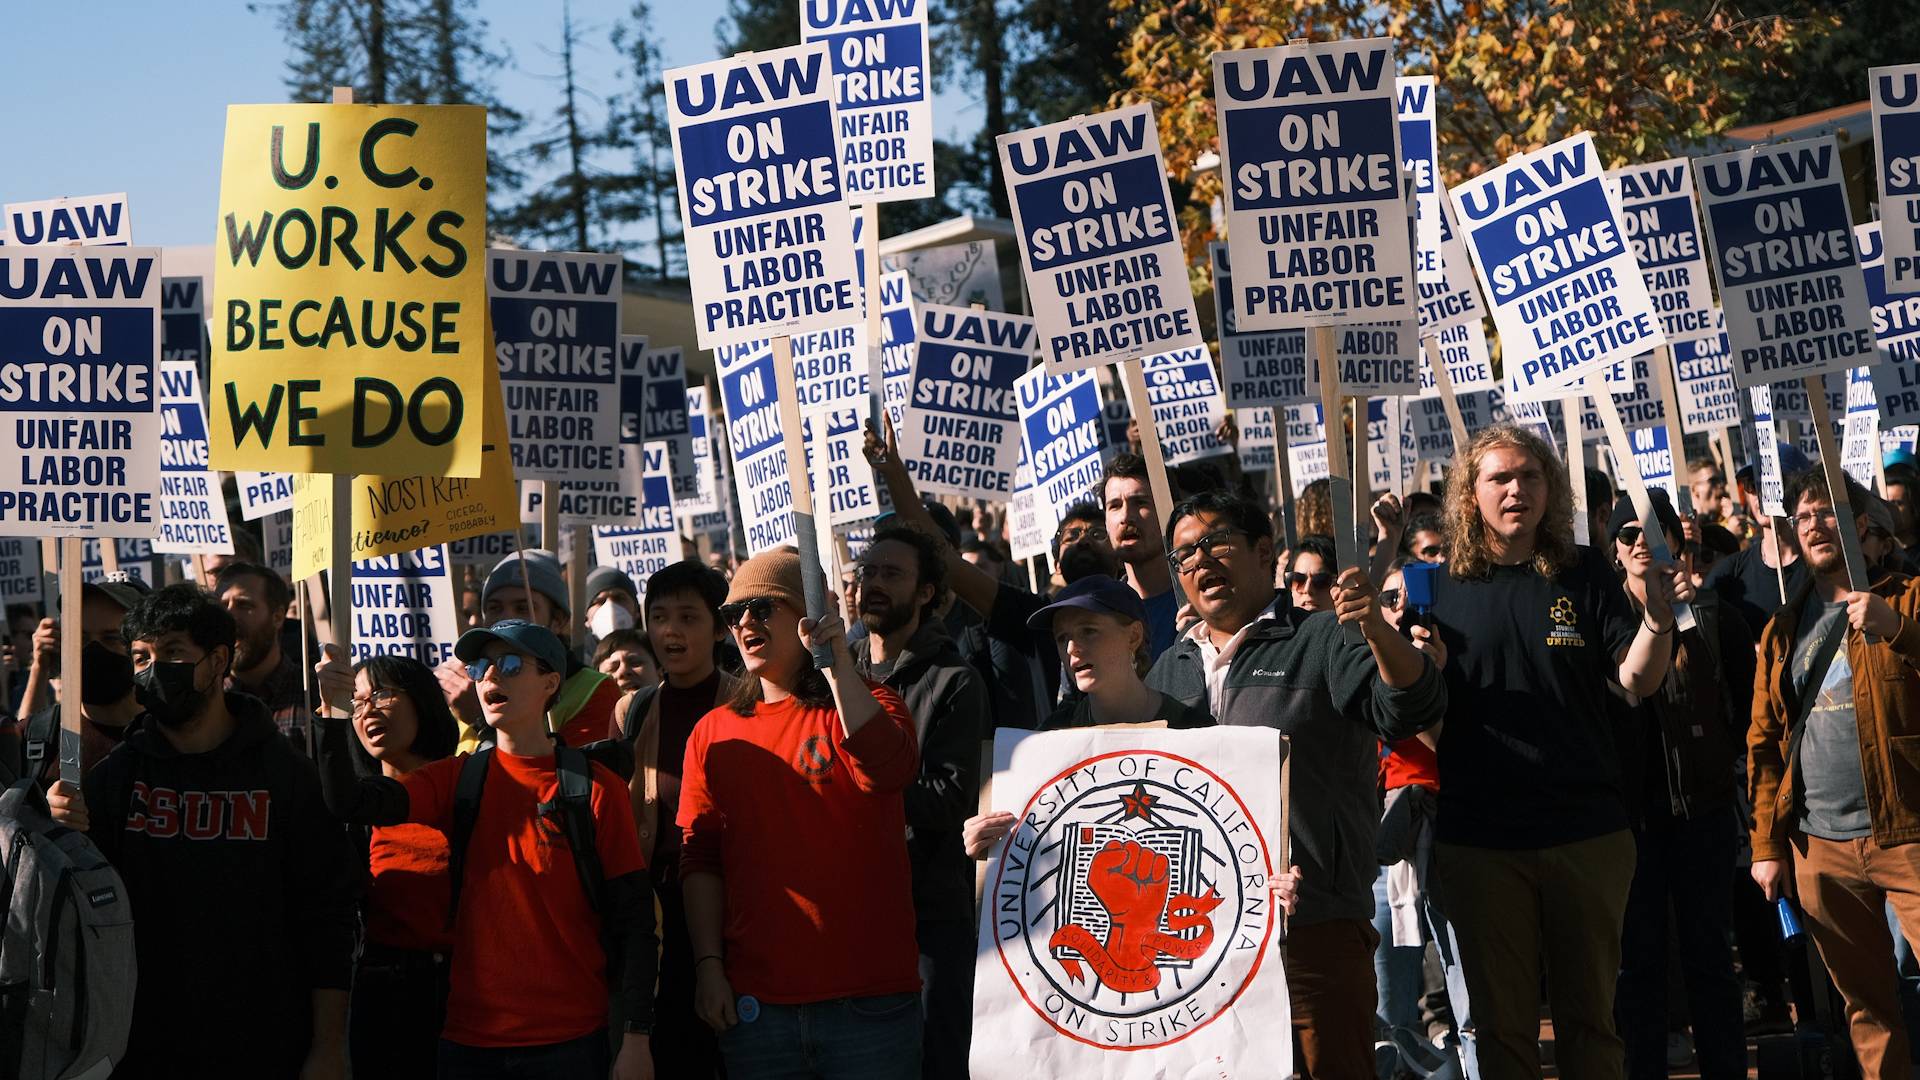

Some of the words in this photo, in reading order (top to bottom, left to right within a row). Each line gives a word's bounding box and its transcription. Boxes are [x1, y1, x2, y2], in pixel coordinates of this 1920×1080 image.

[807, 0, 917, 29] UAW
[841, 33, 886, 68] ON
[674, 53, 823, 117] UAW
[833, 66, 921, 103] TRIKE
[1223, 50, 1386, 101] UAW
[726, 117, 785, 163] ON
[841, 110, 909, 138] NFAIR
[1279, 110, 1340, 152] ON
[843, 138, 906, 165] ABOR
[1007, 114, 1146, 175] UAW
[692, 157, 836, 216] STRIKE
[846, 162, 926, 193] ACTICE
[1237, 153, 1392, 200] STRIKE
[1461, 143, 1586, 220] UAW
[1620, 166, 1683, 200] AW
[1702, 145, 1832, 197] UAW
[1062, 172, 1117, 214] ON
[13, 203, 122, 245] UAW
[1032, 203, 1167, 261] STRIKE
[1259, 208, 1379, 244] UNFAIR
[1516, 200, 1568, 245] ON
[1754, 197, 1806, 235] ON
[224, 206, 468, 278] WORKS
[713, 213, 825, 258] UNFAIR
[1633, 231, 1697, 264] RIKE
[1724, 229, 1850, 278] STRIKE
[723, 249, 825, 293] LABOR
[1055, 253, 1161, 297] UNFAIR
[1268, 243, 1375, 279] LABOR
[1493, 220, 1618, 296] STRIKE
[0, 259, 153, 299] UAW
[493, 259, 617, 294] UAW
[1642, 268, 1690, 291] FAIR
[1746, 275, 1845, 313] UNFAIR
[705, 280, 854, 332] PRACTICE
[1067, 284, 1162, 328] LABOR
[1246, 276, 1405, 315] PRACTICE
[1419, 290, 1475, 326] TICE
[1519, 267, 1617, 324] UNFAIR
[1651, 291, 1689, 312] BOR
[226, 296, 461, 354] BECAUSE
[530, 306, 577, 338] ON
[924, 311, 1033, 348] UAW
[1533, 295, 1622, 349] LABOR
[1660, 310, 1710, 334] TICE
[1756, 304, 1845, 342] LABOR
[1870, 297, 1920, 335] STR
[42, 315, 103, 356] ON
[791, 326, 855, 357] NFAIR
[1051, 309, 1192, 362] PRACTICE
[1337, 331, 1398, 355] ABOR
[1522, 313, 1654, 385] PRACTICE
[1694, 338, 1720, 357] ON
[1741, 329, 1872, 374] PRACTICE
[496, 342, 613, 376] STRIKE
[796, 352, 851, 380] ABOR
[950, 351, 993, 381] ON
[1143, 348, 1202, 368] AW
[1152, 368, 1186, 384] ON
[1314, 359, 1415, 383] ACTICE
[0, 362, 149, 404] STRIKE
[507, 386, 598, 412] UNFAIR
[740, 366, 764, 408] ON
[797, 374, 869, 405] ACTICE
[915, 378, 1016, 415] STRIKE
[1148, 379, 1215, 402] TRIKE
[1231, 381, 1305, 400] PRACTI
[1691, 379, 1731, 395] UNFAI
[224, 380, 325, 450] WE
[351, 376, 464, 449] DO
[511, 416, 593, 440] LABOR
[732, 402, 782, 454] STRIK
[923, 415, 1003, 443] UNFAIR
[1047, 397, 1075, 436] ON
[1158, 418, 1210, 439] ABOR
[1688, 408, 1736, 425] PRACTI
[16, 420, 132, 449] UNFAIR
[923, 439, 995, 466] LABOR
[1163, 433, 1227, 460] ACTIC
[1635, 428, 1655, 449] ON
[21, 456, 126, 486] LABOR
[161, 440, 209, 468] RIKE
[511, 444, 612, 470] RACTICE
[746, 449, 787, 489] UNFAIR
[1637, 449, 1671, 477] RIKE
[905, 459, 1010, 492] PRACTICE
[1049, 460, 1101, 504] UNFAIR
[0, 492, 152, 523] PRACTICE
[446, 503, 487, 520] CICERO,
[558, 495, 637, 517] ACTICE
[753, 482, 792, 518] LABOR
[829, 485, 872, 512] TICE
[449, 515, 496, 533] PROBABLY
[750, 512, 797, 551] PRACTI
[611, 538, 667, 558] UNFAIR
[0, 577, 37, 594] TICE
[352, 584, 432, 609] UNFAIR
[357, 614, 432, 638] LABOR
[1546, 637, 1586, 648] UNITED
[125, 781, 271, 840] CSUN
[1001, 765, 1096, 941] UNIVERSITY
[1119, 757, 1159, 778] OF
[1174, 767, 1265, 951] CALIFORNIA
[1045, 993, 1085, 1029] ON
[1106, 998, 1205, 1042] STRIKE
